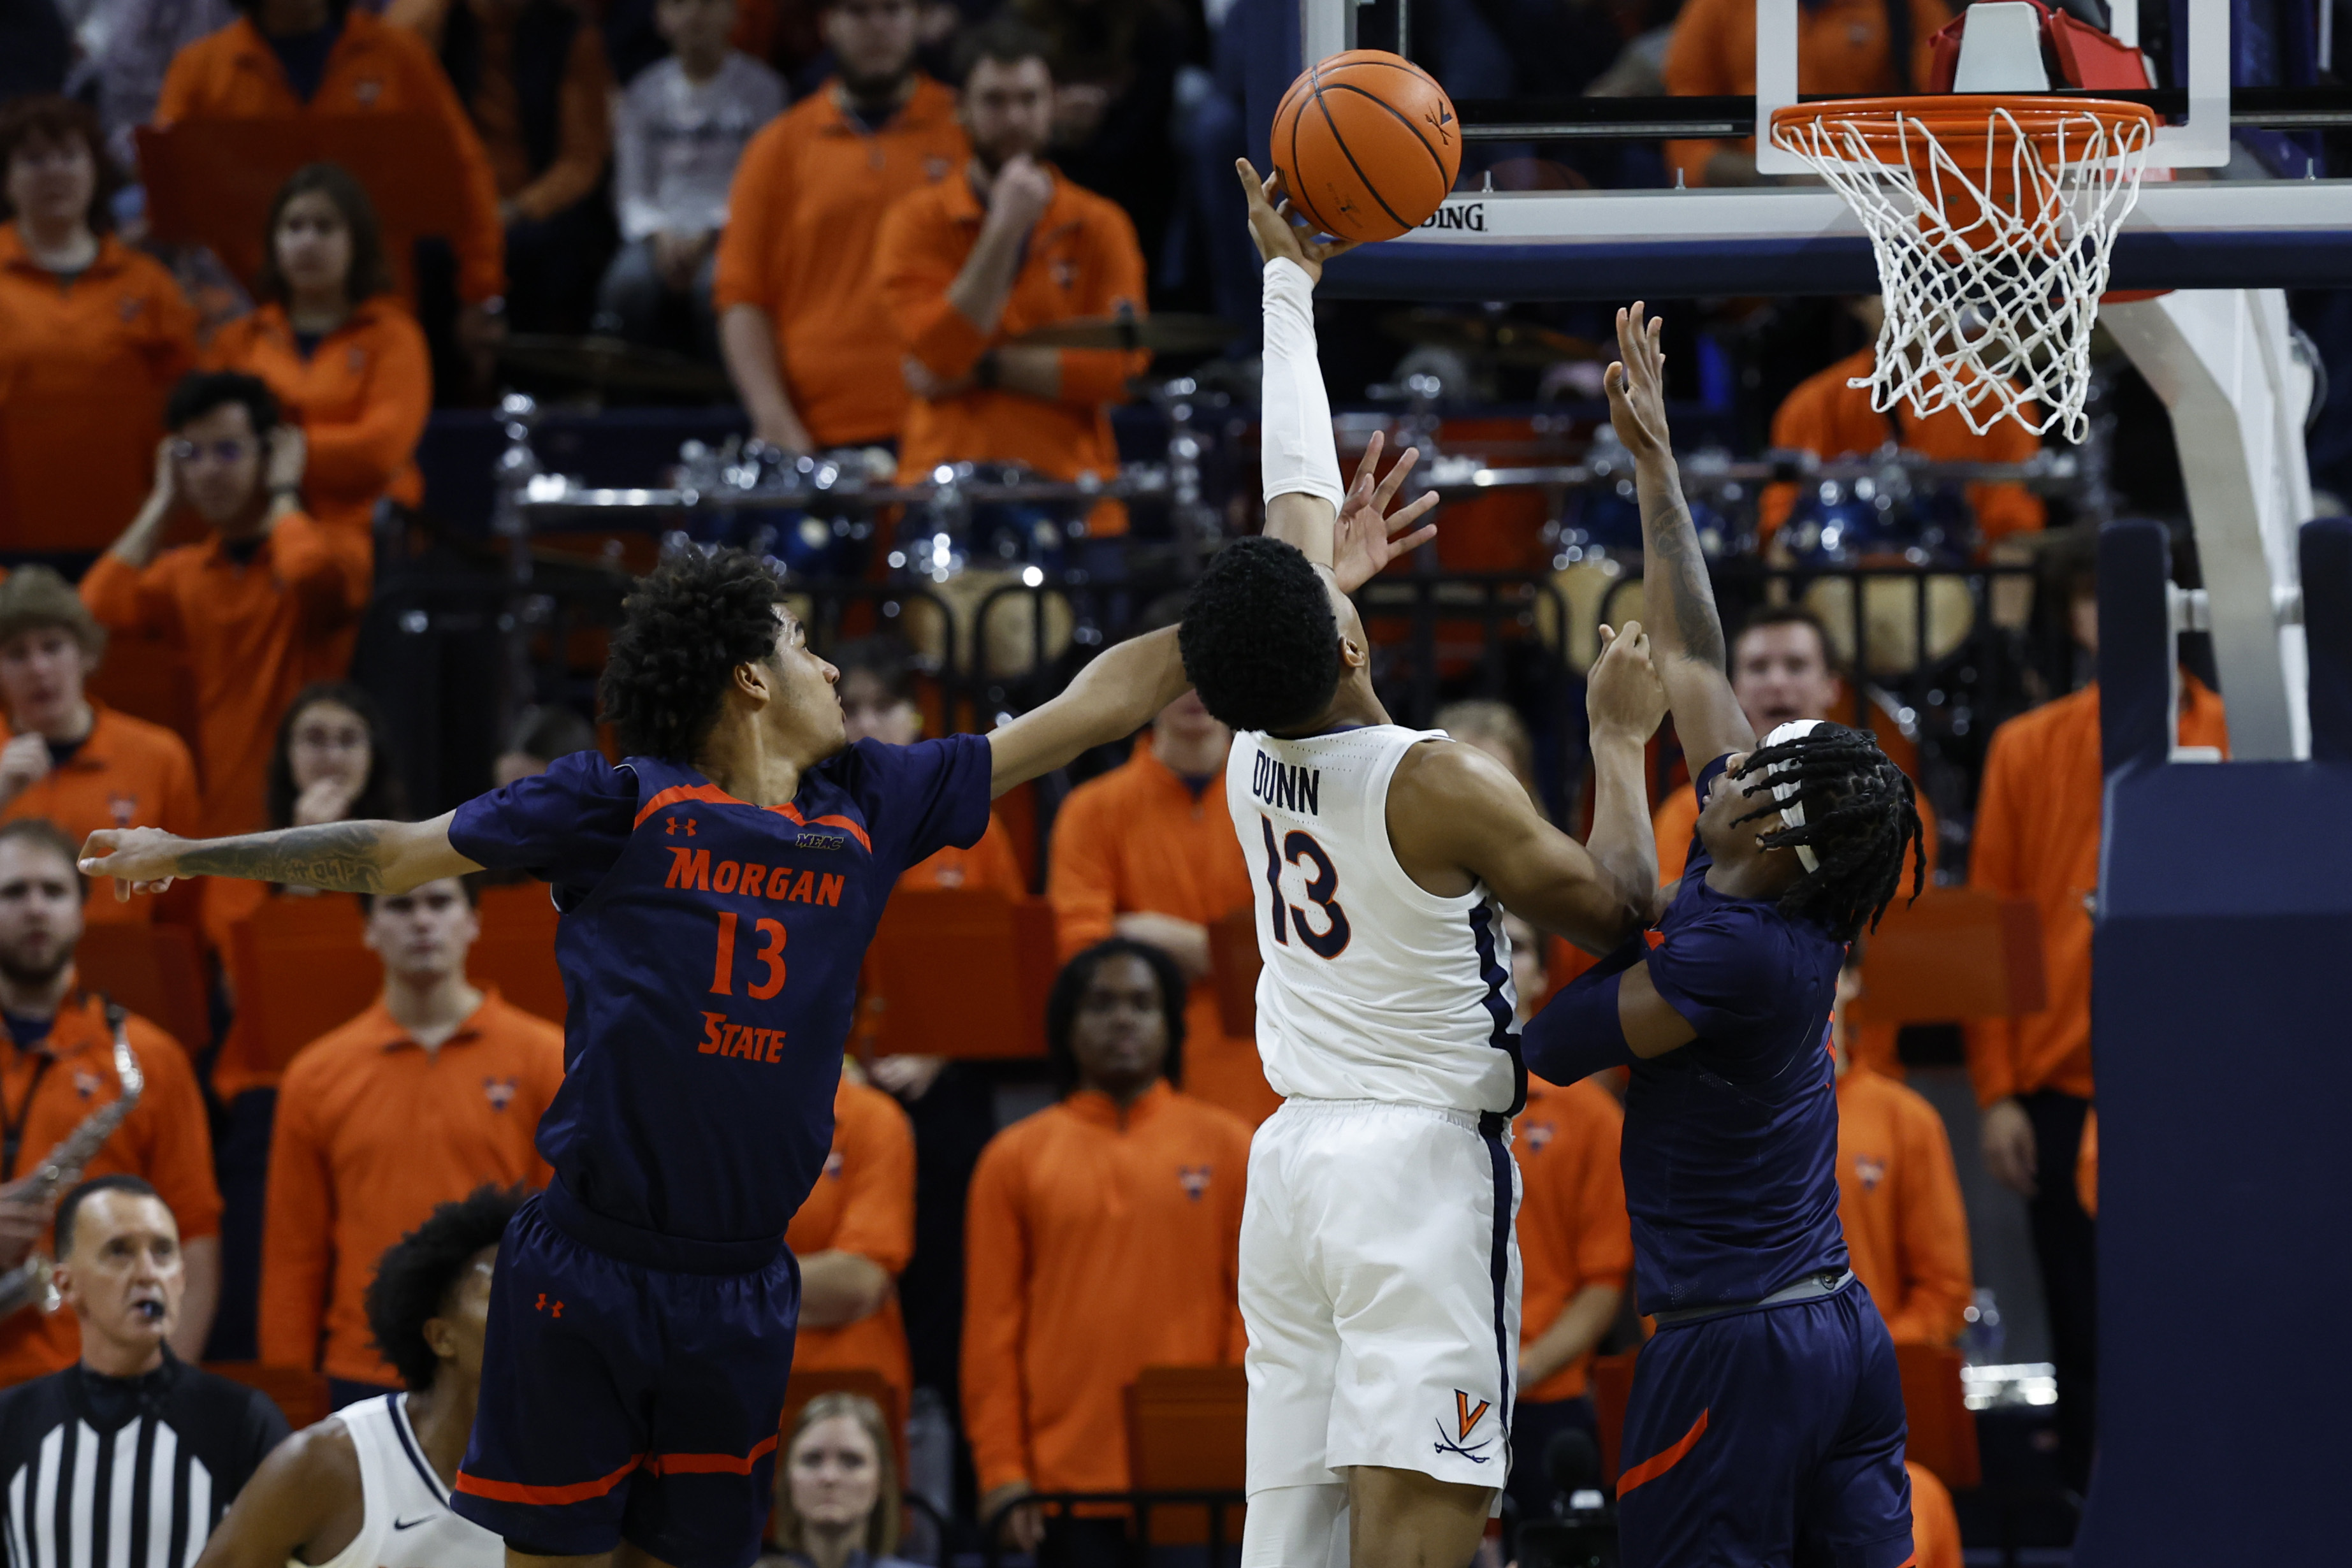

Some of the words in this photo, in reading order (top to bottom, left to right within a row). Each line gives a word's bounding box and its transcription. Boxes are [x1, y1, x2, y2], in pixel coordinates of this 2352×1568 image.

[1252, 749, 1320, 816] DUNN
[795, 833, 844, 850] MEAC
[664, 846, 845, 907] MORGAN
[1260, 811, 1351, 961] 13
[709, 911, 787, 1000] 13
[698, 1011, 787, 1063] STATE
